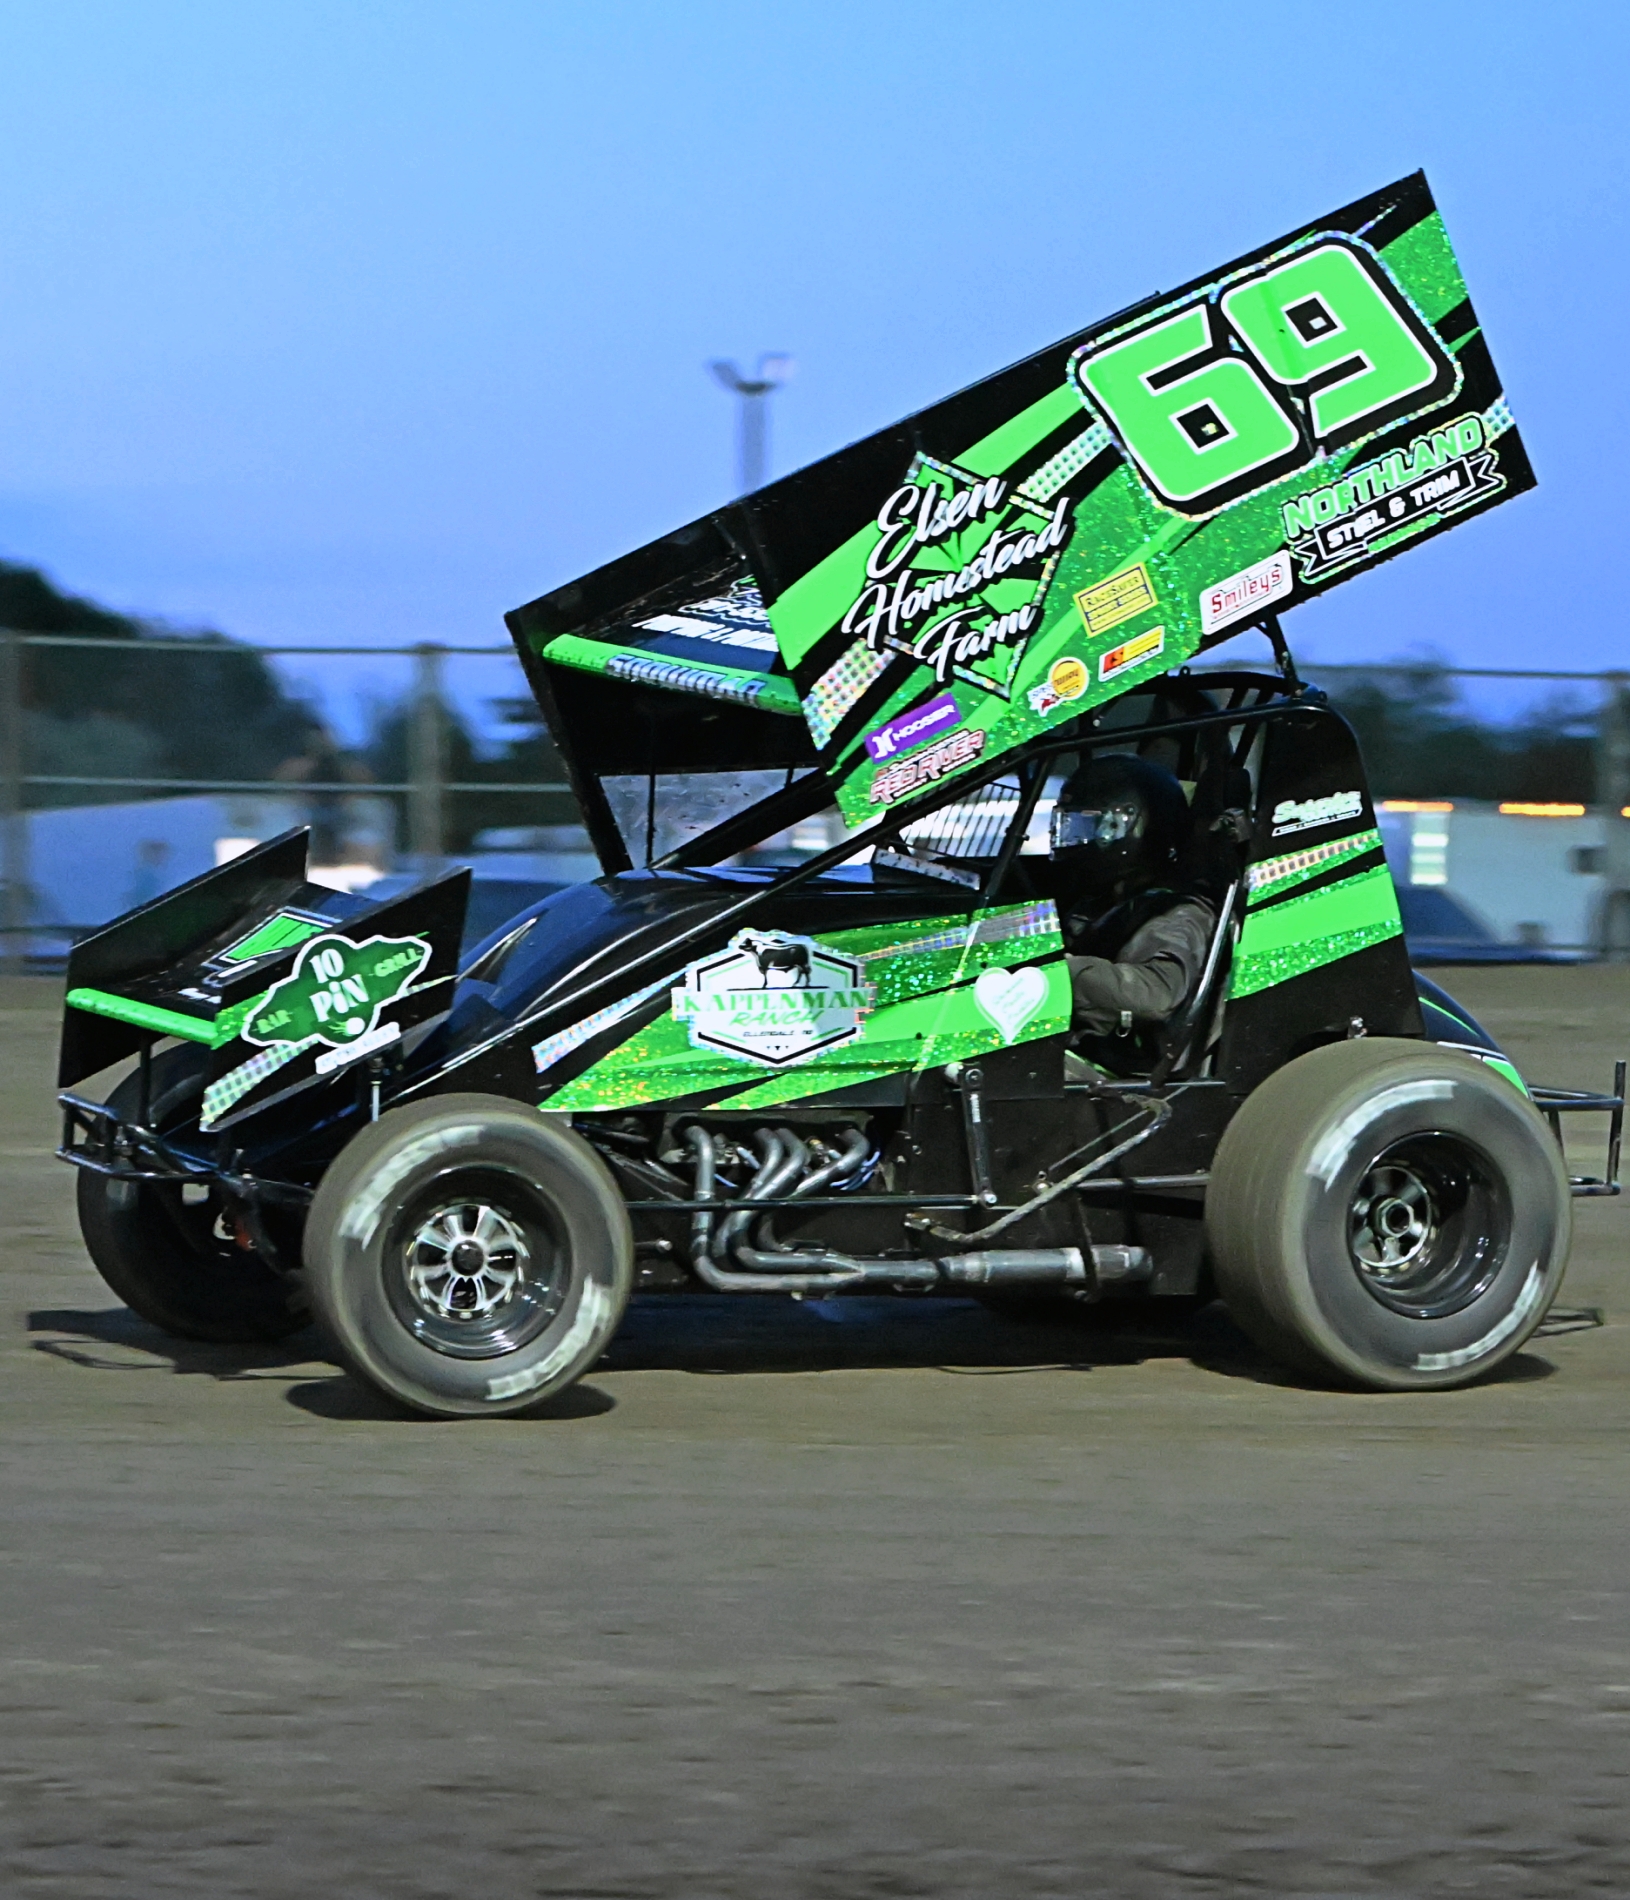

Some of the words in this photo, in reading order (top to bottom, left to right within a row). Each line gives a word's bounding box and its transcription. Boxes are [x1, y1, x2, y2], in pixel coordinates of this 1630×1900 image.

[1079, 244, 1438, 501] 69
[1282, 416, 1483, 538] NORTHLAND
[1389, 497, 1406, 518] &
[1410, 470, 1461, 507] TRIM
[865, 476, 1008, 579] Elsen
[840, 496, 1070, 650] Homestead
[1211, 568, 1281, 614] Smileys
[912, 604, 1038, 682] Farm
[892, 704, 956, 741] HOOSIER
[309, 948, 345, 984] 10
[373, 947, 424, 978] GRILL
[729, 1009, 825, 1027] RANCH
